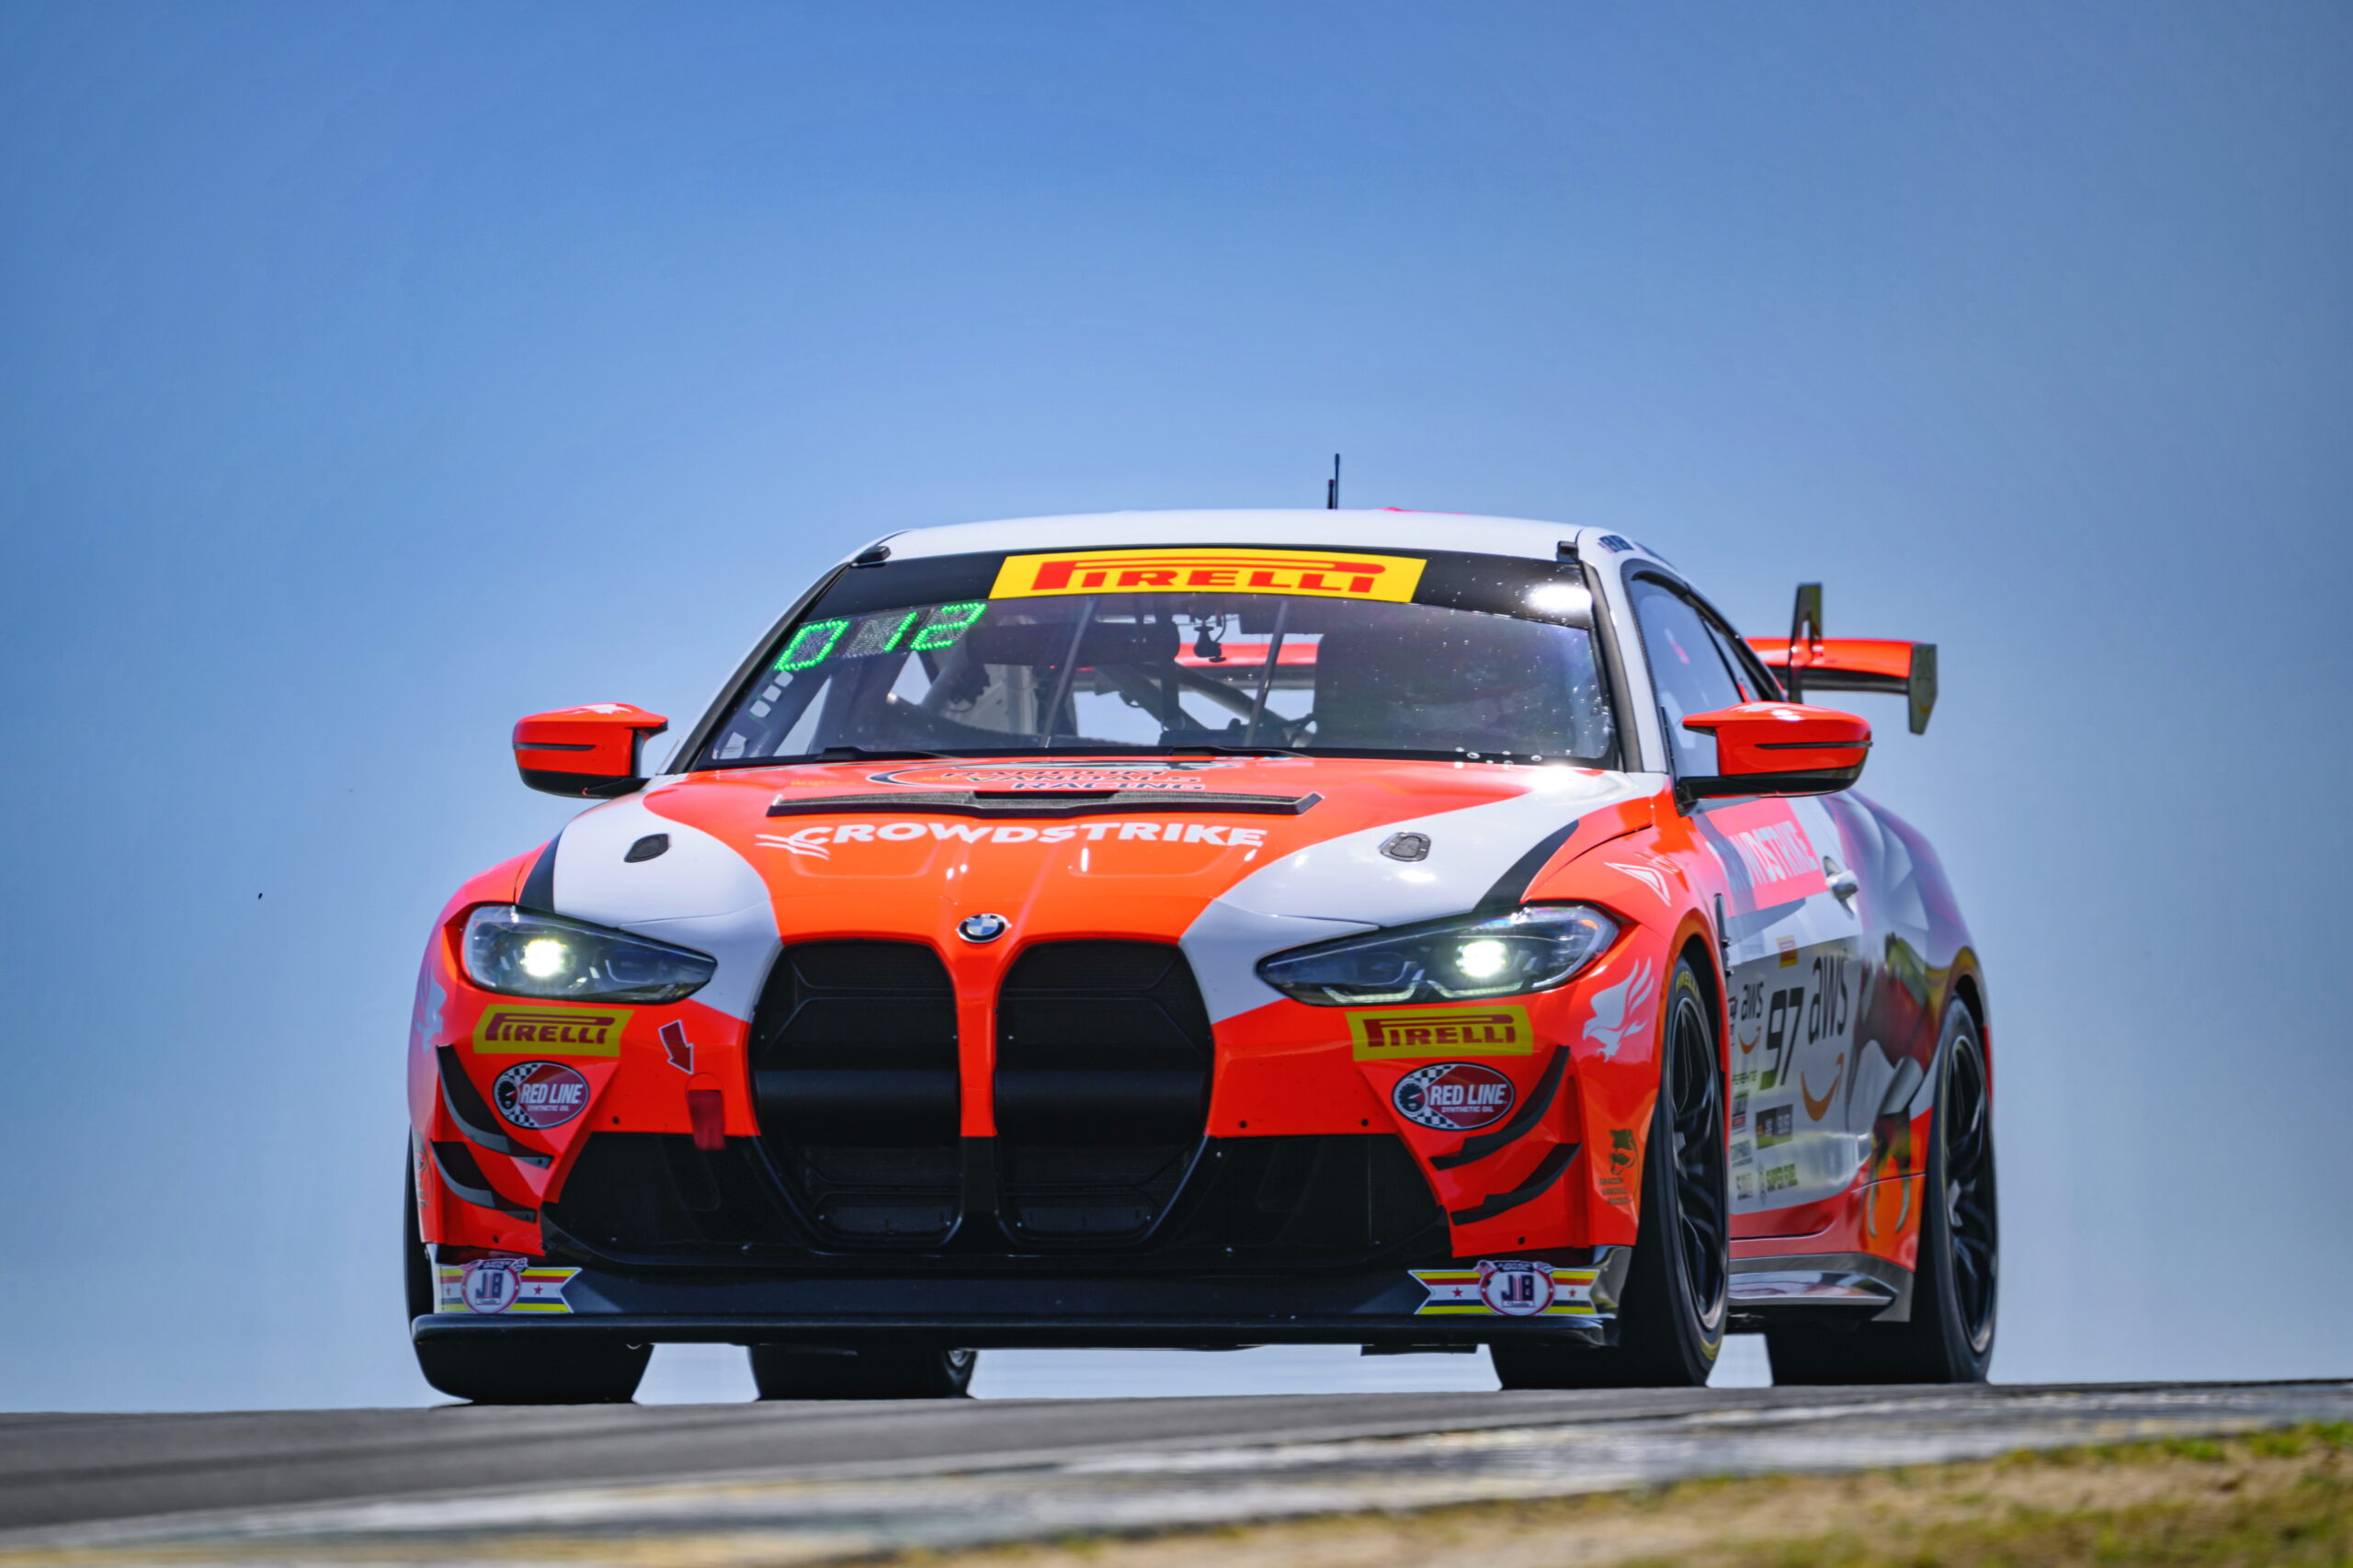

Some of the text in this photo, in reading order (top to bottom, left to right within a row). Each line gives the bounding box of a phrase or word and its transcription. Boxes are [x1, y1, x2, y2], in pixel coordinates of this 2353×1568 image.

[1030, 556, 1386, 594] PIRELLI
[1011, 781, 1205, 790] RACING
[789, 821, 1268, 847] CROWDSTRIKE
[1808, 954, 1848, 1046] aws
[484, 1012, 616, 1045] PIRELLI
[1362, 1014, 1516, 1048] PIRELLI
[1759, 986, 1805, 1091] 97
[520, 1083, 584, 1105] RED LINE
[1430, 1083, 1507, 1106] RED LINE
[1440, 1106, 1481, 1114] SYNTHETIC
[475, 1272, 504, 1298] JB
[1500, 1274, 1535, 1301] JB
